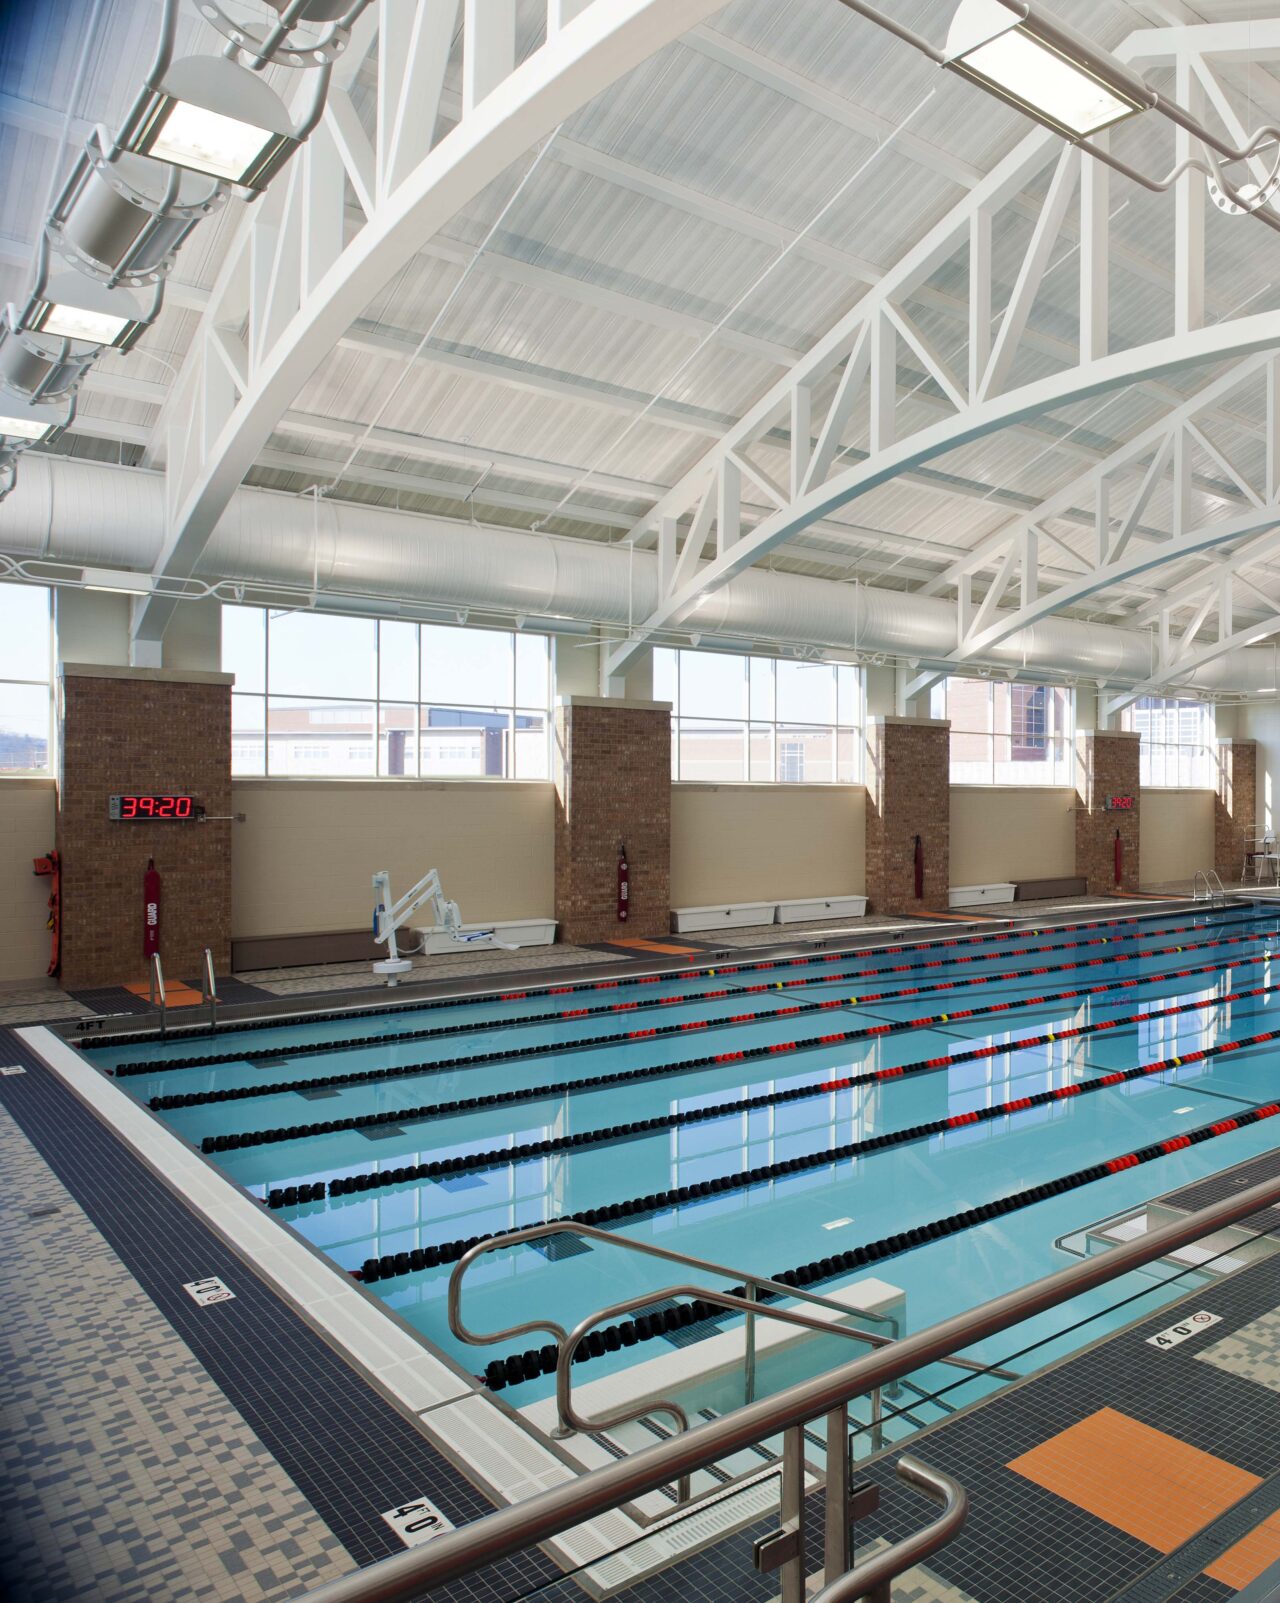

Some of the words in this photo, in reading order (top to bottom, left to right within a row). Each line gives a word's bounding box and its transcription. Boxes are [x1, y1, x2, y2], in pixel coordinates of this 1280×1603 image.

[122, 798, 191, 817] 39:20
[148, 903, 157, 926] GUARD
[76, 1020, 105, 1030] 4FT
[393, 1504, 426, 1518] 4
